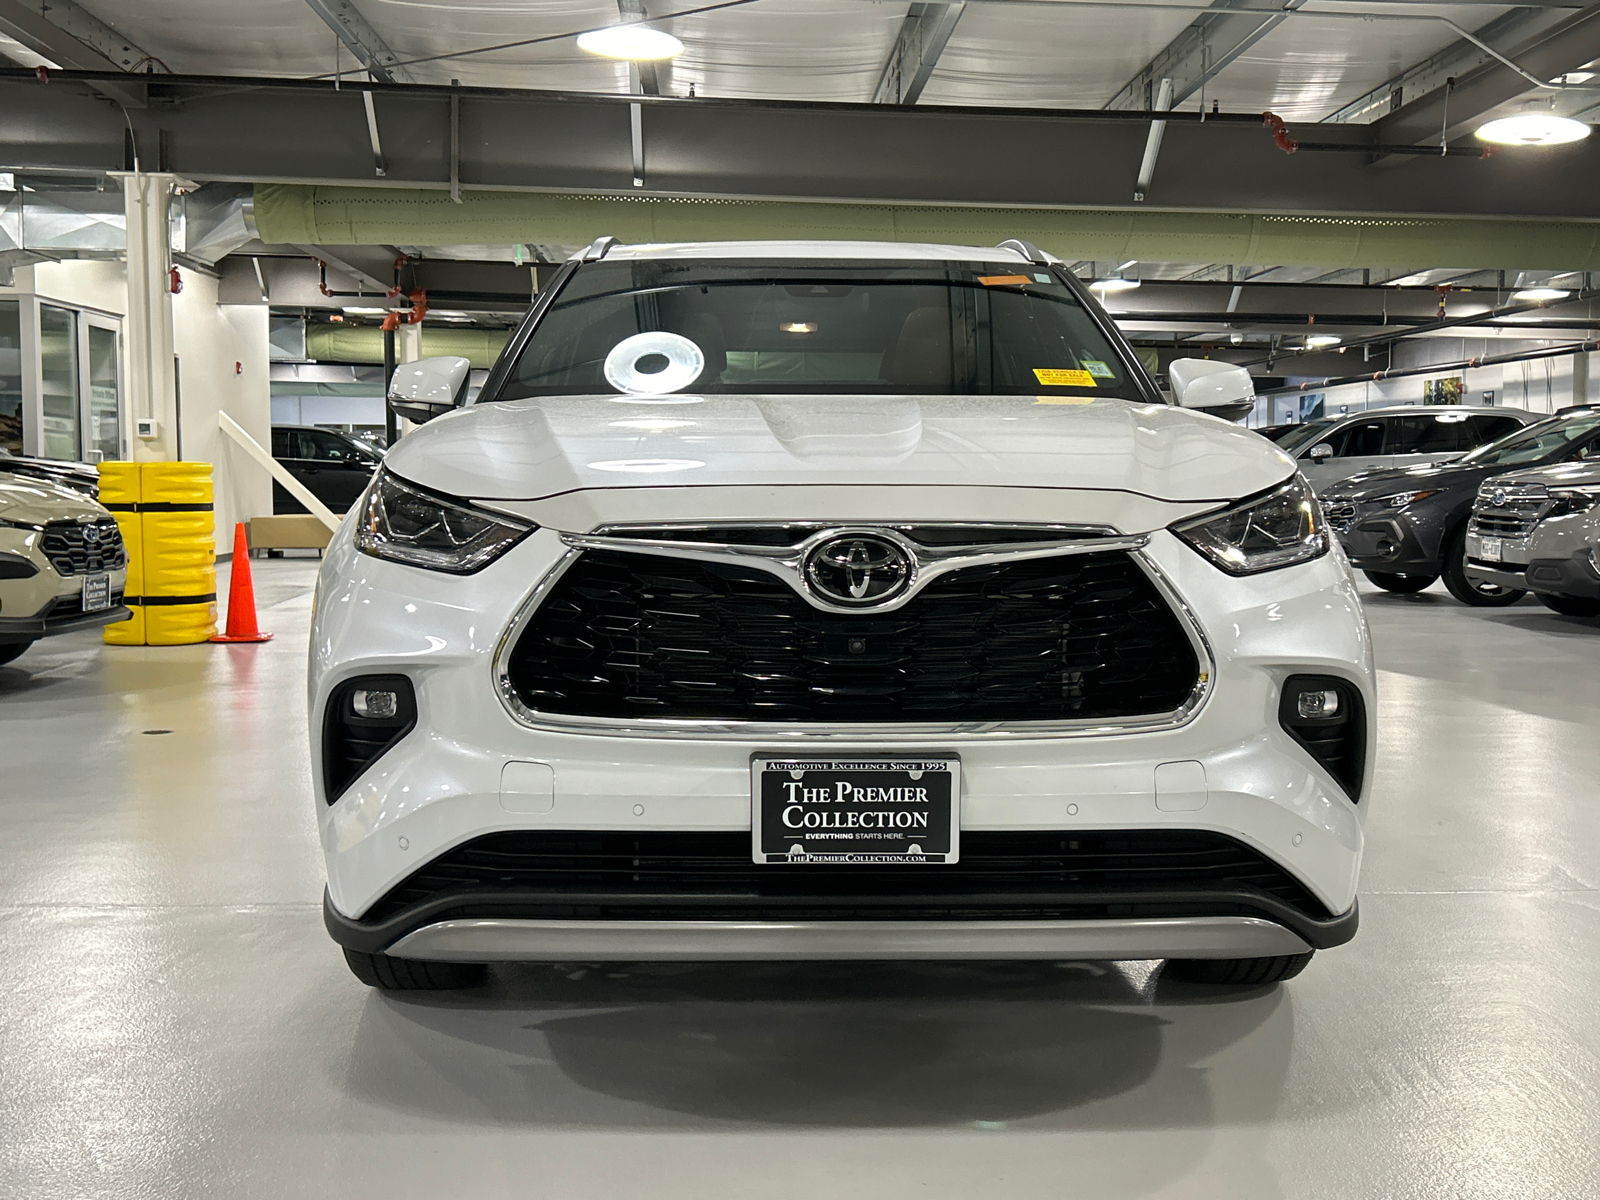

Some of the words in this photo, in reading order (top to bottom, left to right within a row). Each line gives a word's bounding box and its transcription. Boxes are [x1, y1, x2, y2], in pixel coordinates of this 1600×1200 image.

[768, 762, 829, 770] AUTOMOTIVE
[831, 762, 888, 770] EXCELLENCE
[889, 762, 918, 770] SINCE
[919, 762, 946, 770] 1995
[782, 781, 831, 803] THE
[834, 781, 929, 803] PREMIER
[781, 805, 929, 829] COLLECTION
[805, 832, 854, 840] EVERYTHING
[854, 832, 883, 840] STARTS
[883, 832, 905, 840] HERE.
[784, 853, 927, 863] THEPREMIERCOLLECTION.COM
